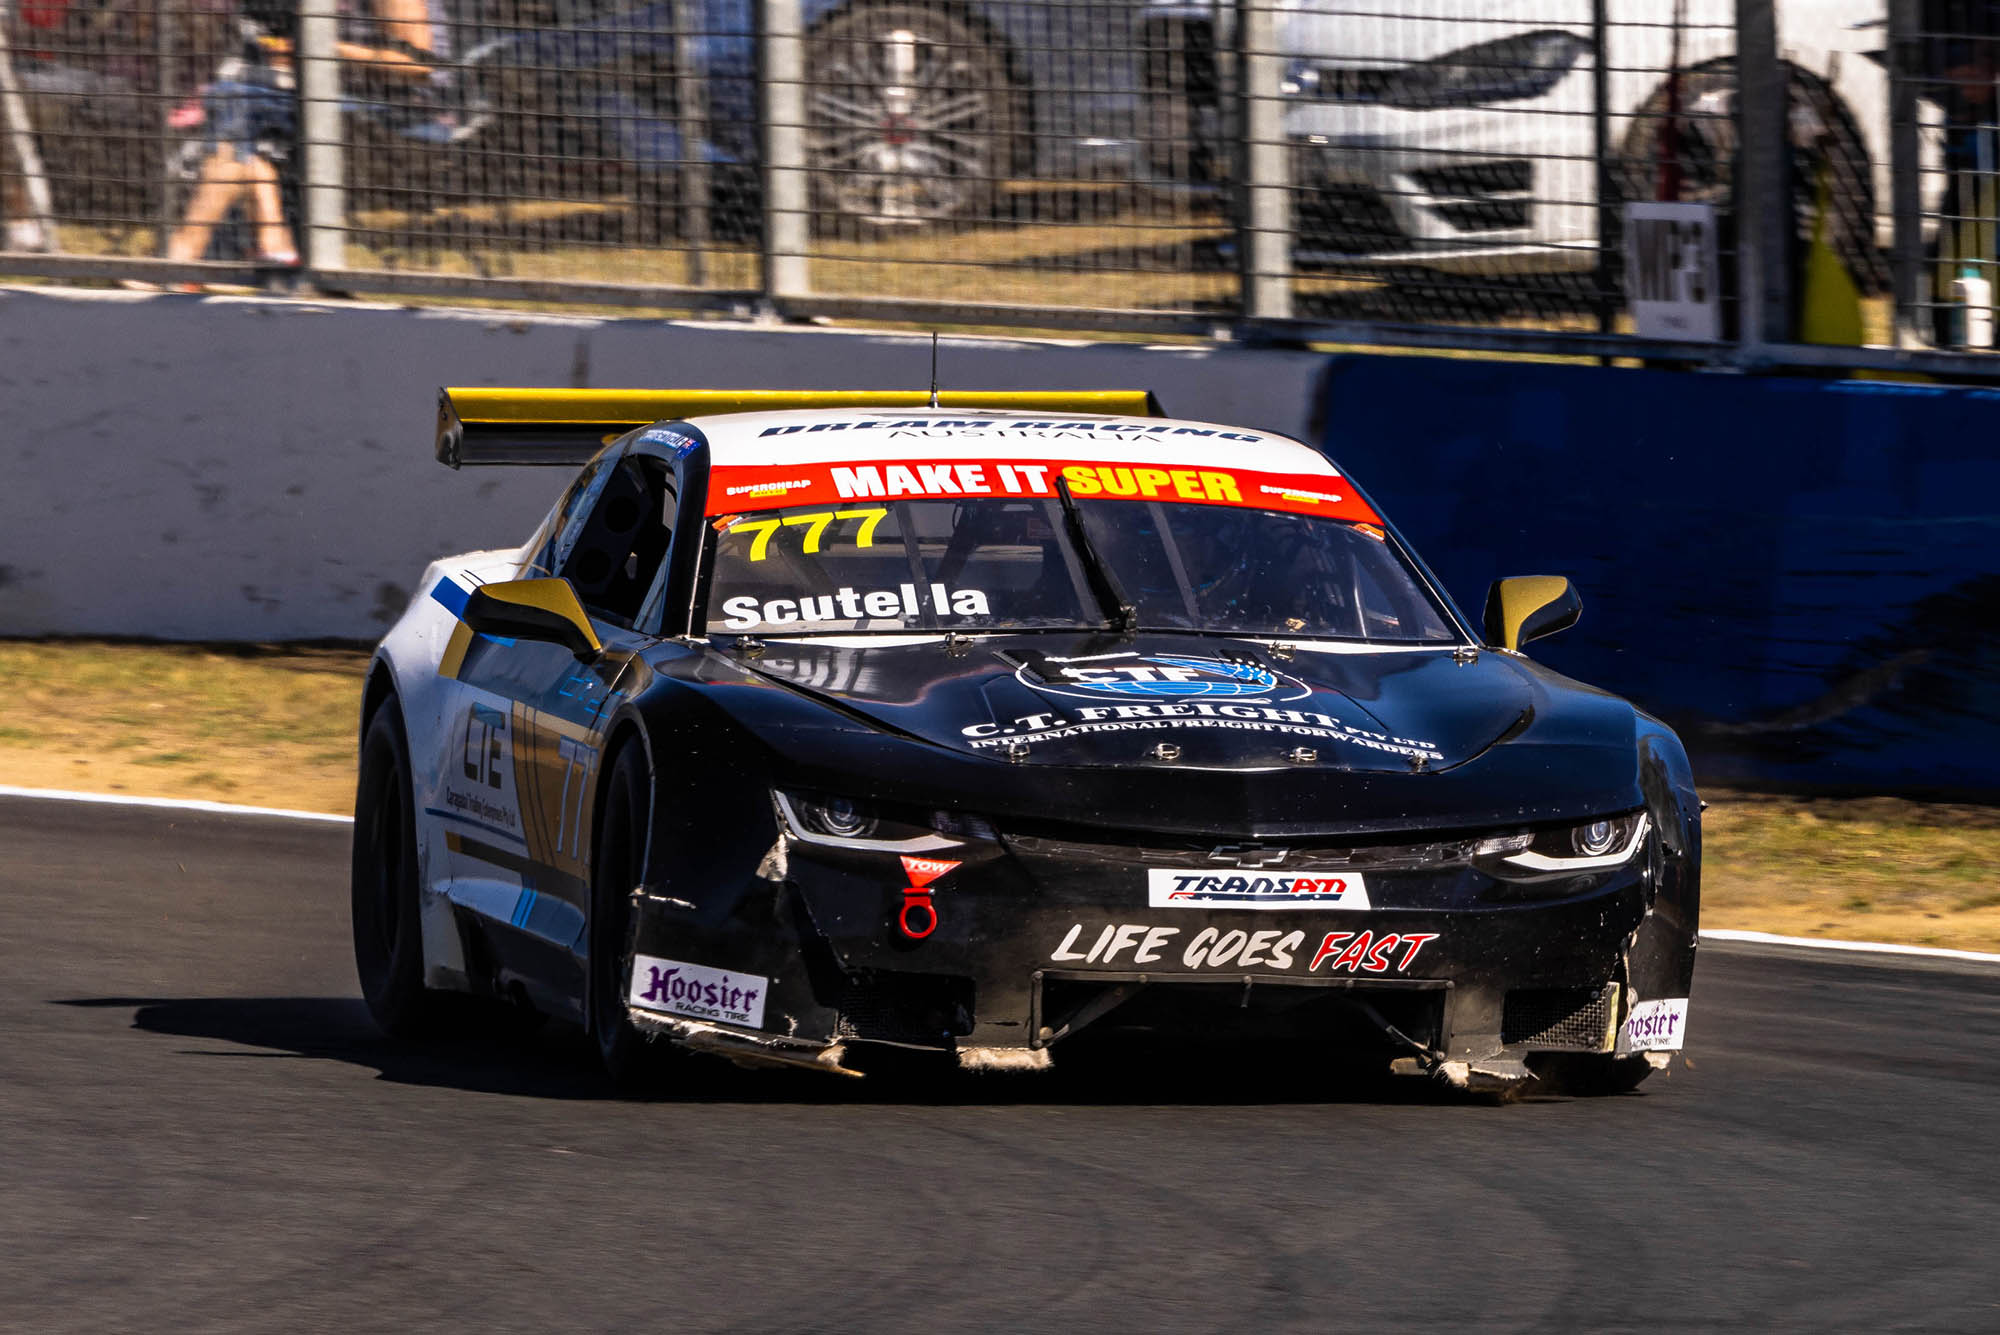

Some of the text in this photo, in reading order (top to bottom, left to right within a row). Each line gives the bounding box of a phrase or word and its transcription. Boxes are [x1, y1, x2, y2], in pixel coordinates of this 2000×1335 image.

[757, 420, 1264, 443] DREAM RACING
[888, 430, 1164, 443] AUSTRALIA
[830, 464, 1244, 503] MAKE IT SUPER
[728, 507, 889, 562] 777
[721, 583, 991, 630] Scutella
[961, 712, 1067, 737] C.T.
[1074, 703, 1341, 729] FREIGHT
[1392, 736, 1437, 749] LTD
[966, 719, 1446, 760] INTERNATIONAL FREIGHT FORWARDERS
[908, 860, 951, 872] TOW
[1050, 923, 1441, 973] LIFE GOES FAST
[640, 965, 759, 1013] Hoosier
[674, 1001, 750, 1023] RACING TIRE
[1627, 1006, 1680, 1039] oosier
